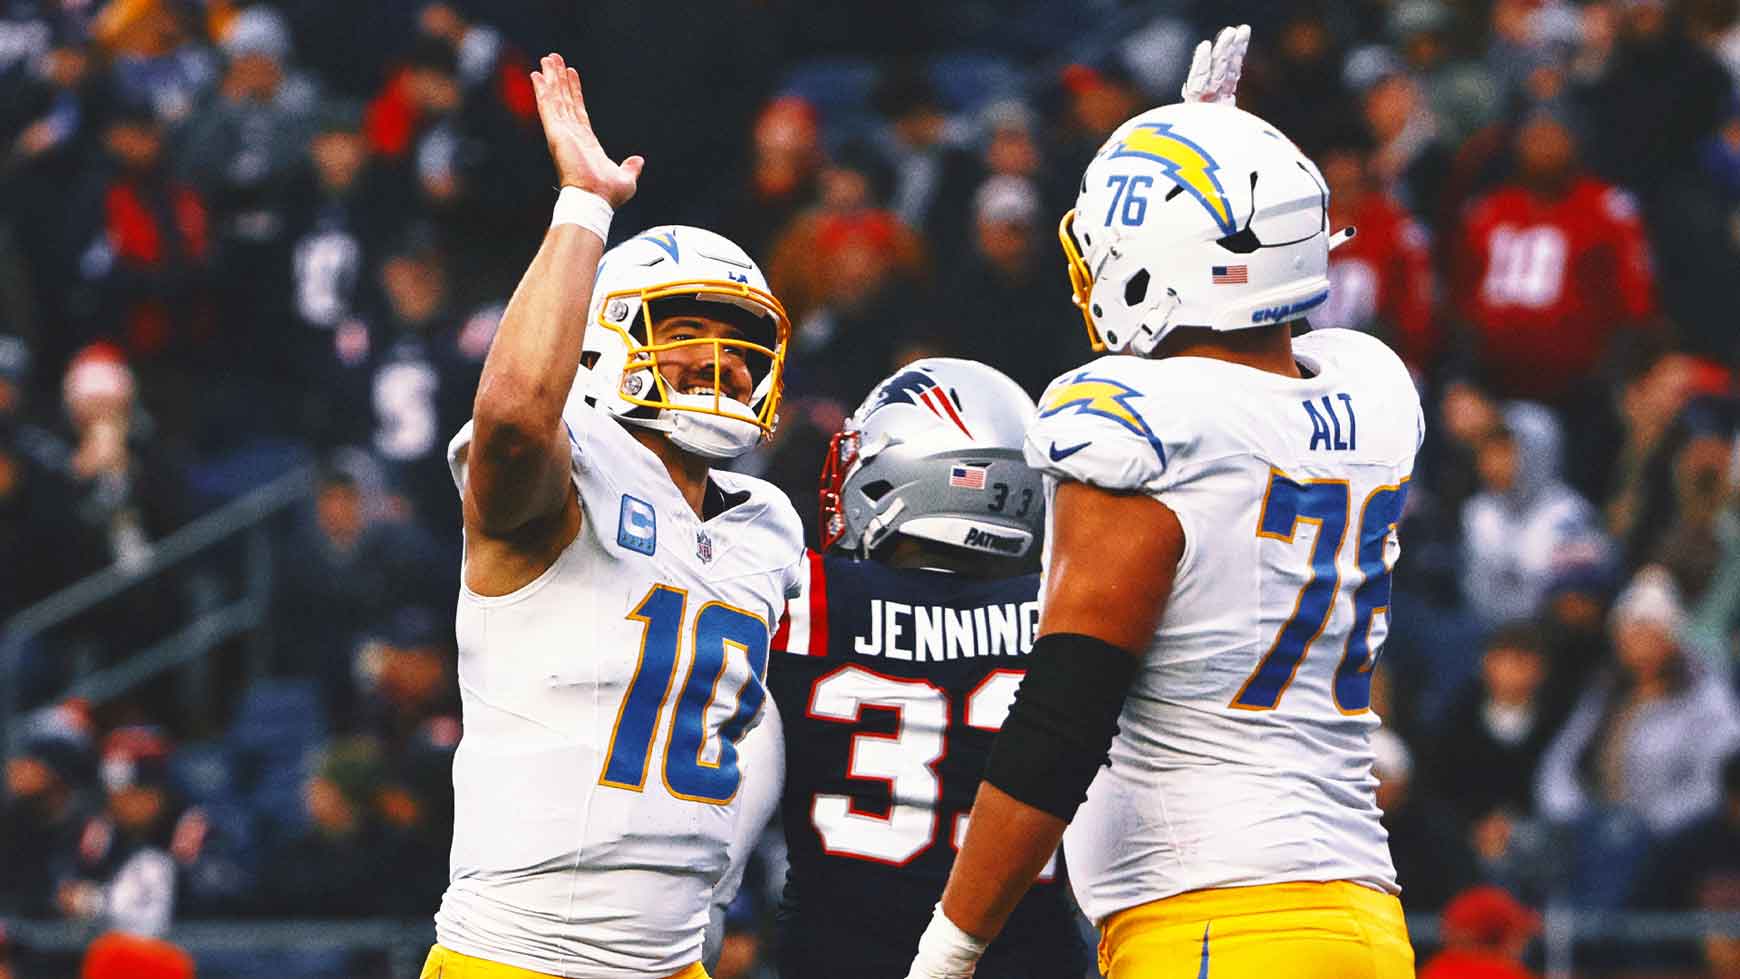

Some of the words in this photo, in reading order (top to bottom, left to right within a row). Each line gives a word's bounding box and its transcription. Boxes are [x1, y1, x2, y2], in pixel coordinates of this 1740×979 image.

[1104, 175, 1154, 227] 76
[728, 271, 748, 284] LA
[1302, 393, 1355, 450] ALT
[1228, 467, 1411, 716] 76
[598, 582, 768, 806] 10
[805, 662, 1030, 868] 3
